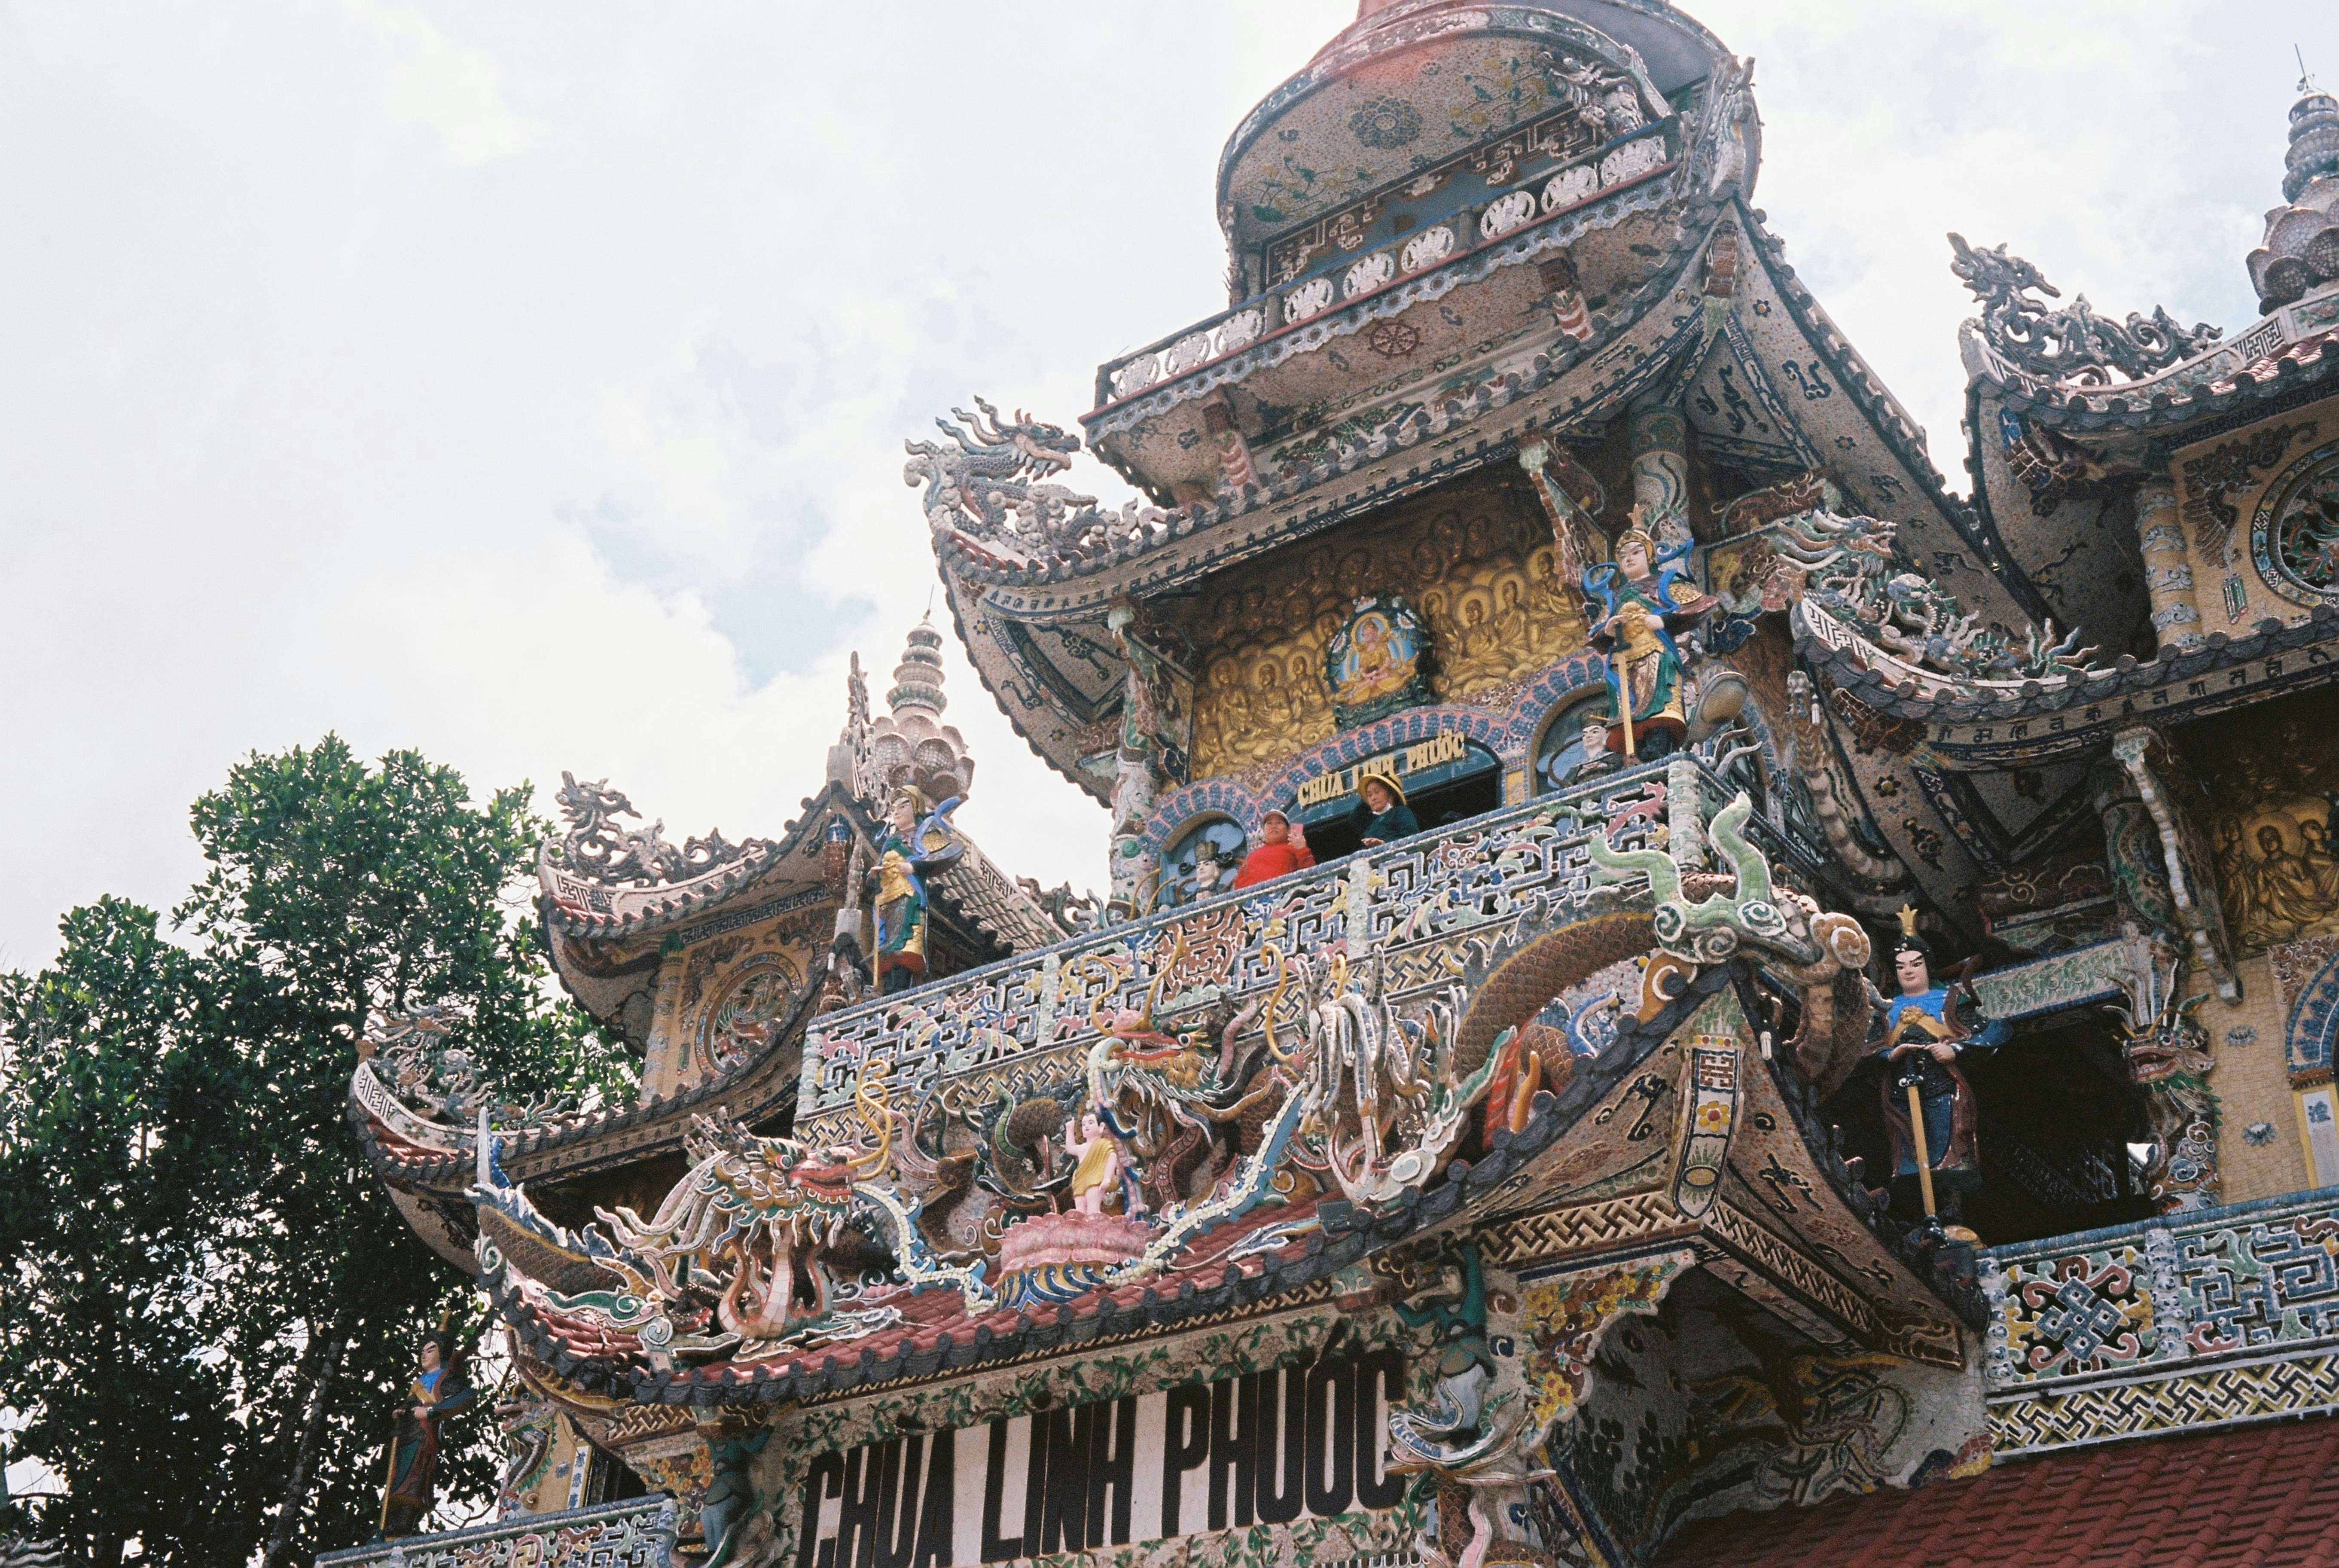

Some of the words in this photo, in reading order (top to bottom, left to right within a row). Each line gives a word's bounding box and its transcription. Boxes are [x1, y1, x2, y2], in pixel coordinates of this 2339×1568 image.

[1298, 770, 1344, 805] CHÙA
[796, 1414, 955, 1568] CHÙA
[981, 1389, 1137, 1563] LINH
[1162, 1317, 1406, 1539] PHƯỚC
